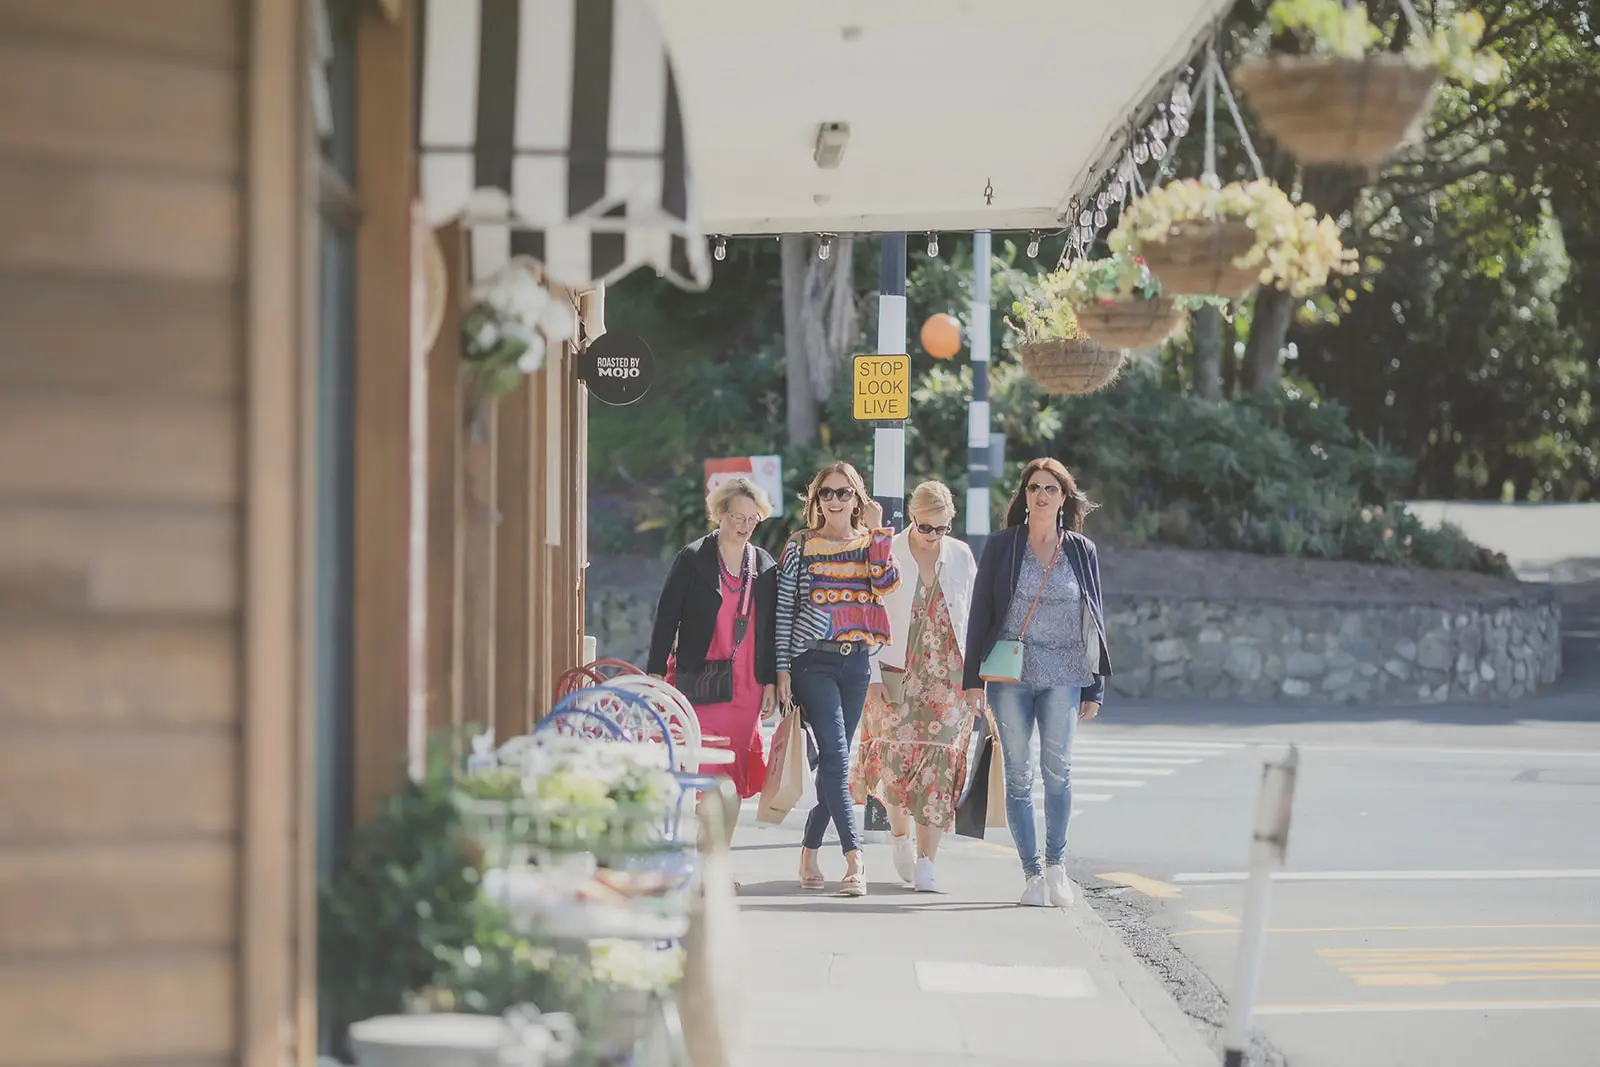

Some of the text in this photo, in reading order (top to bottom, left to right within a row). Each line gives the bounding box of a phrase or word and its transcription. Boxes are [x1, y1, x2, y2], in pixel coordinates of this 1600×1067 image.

[597, 357, 640, 368] ROASTED BY
[859, 361, 903, 376] STOP
[597, 367, 640, 379] MOJO
[858, 380, 903, 395] LOOK
[863, 399, 898, 414] LIVE
